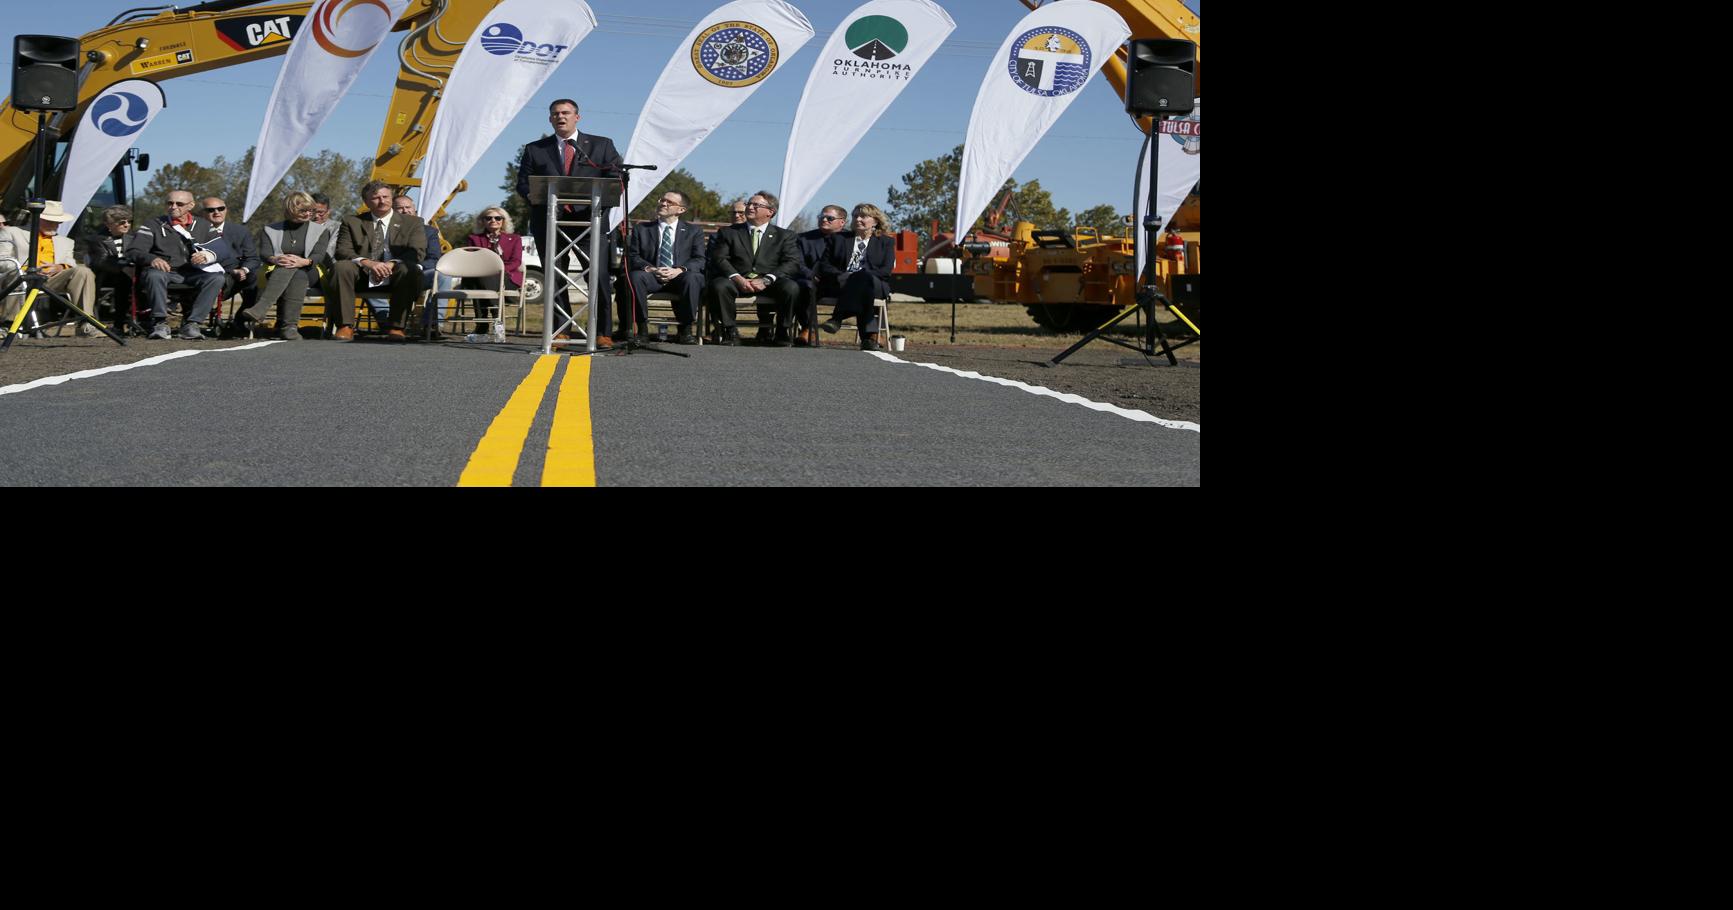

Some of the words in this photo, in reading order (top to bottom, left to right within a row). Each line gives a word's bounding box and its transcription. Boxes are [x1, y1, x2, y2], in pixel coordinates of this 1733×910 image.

[246, 16, 291, 46] CAT
[743, 24, 766, 37] STATE
[140, 59, 172, 69] WARREN
[177, 52, 191, 62] CAT
[833, 58, 911, 71] OKLAHOMA
[833, 65, 909, 76] TURNPIKE
[1008, 60, 1018, 76] CITY
[832, 70, 909, 81] AUTHORITY
[1012, 74, 1022, 85] OF
[1052, 68, 1089, 97] OKLAHOMA
[1022, 83, 1048, 97] TULSA
[1161, 120, 1191, 135] TULSA
